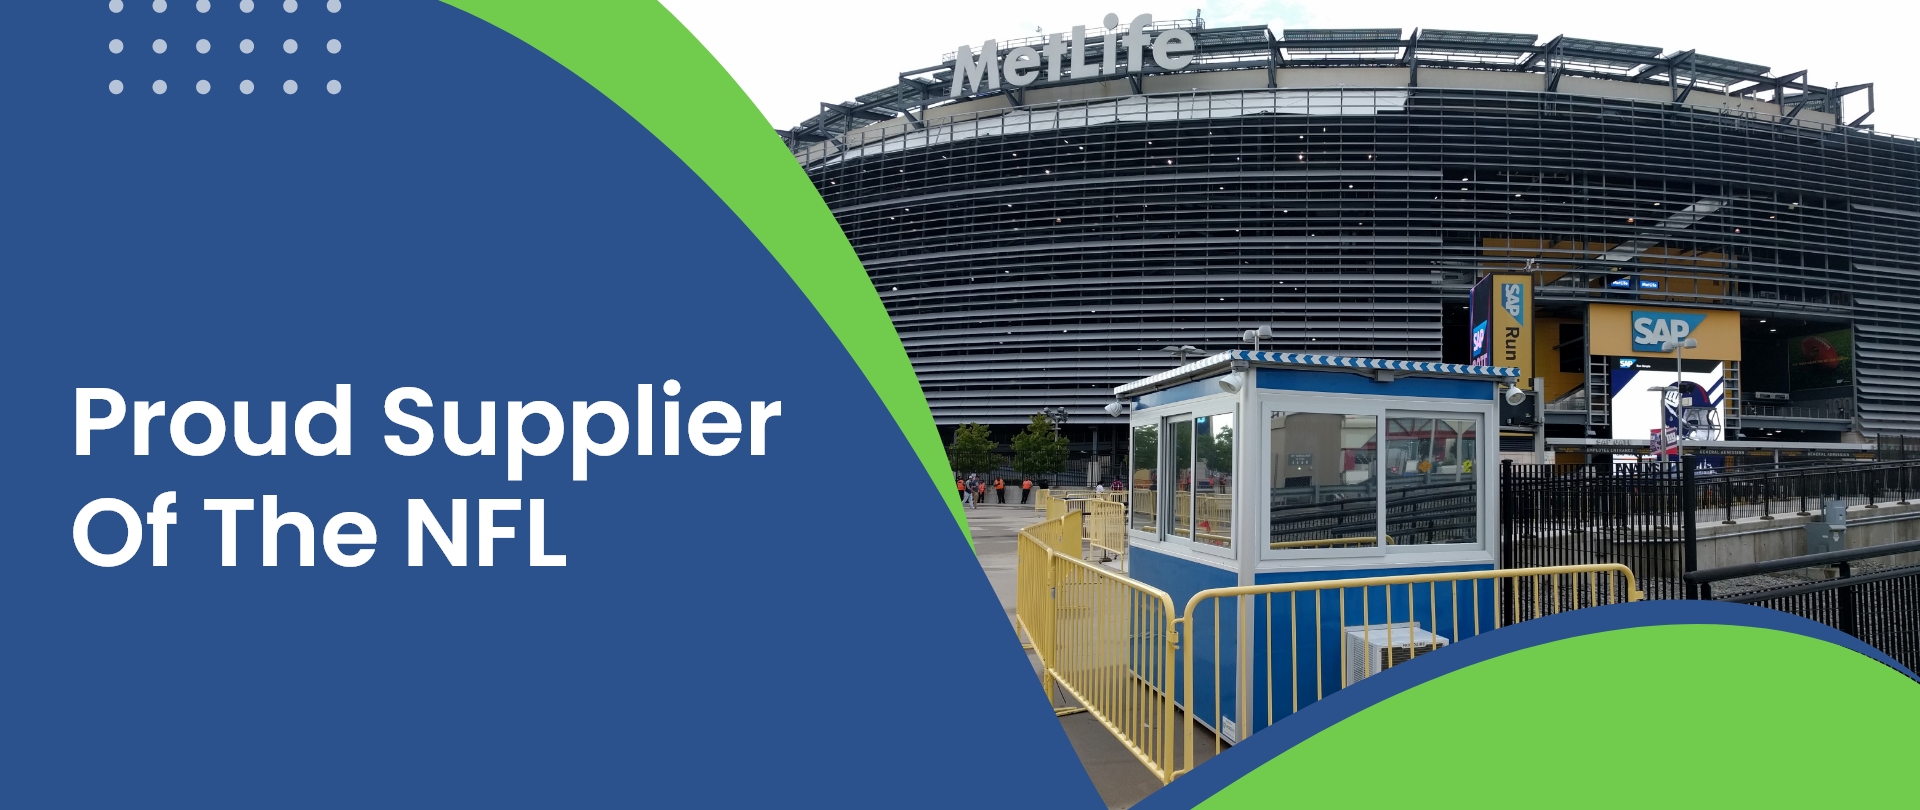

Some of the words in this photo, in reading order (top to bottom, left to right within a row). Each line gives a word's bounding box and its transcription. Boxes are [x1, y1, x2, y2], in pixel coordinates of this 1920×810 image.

[950, 13, 1195, 97] MetLife
[1505, 284, 1520, 317] SAP
[1473, 328, 1485, 352] SAP
[1505, 327, 1520, 361] Run
[1634, 317, 1690, 346] SAP
[1620, 360, 1633, 368] SAP
